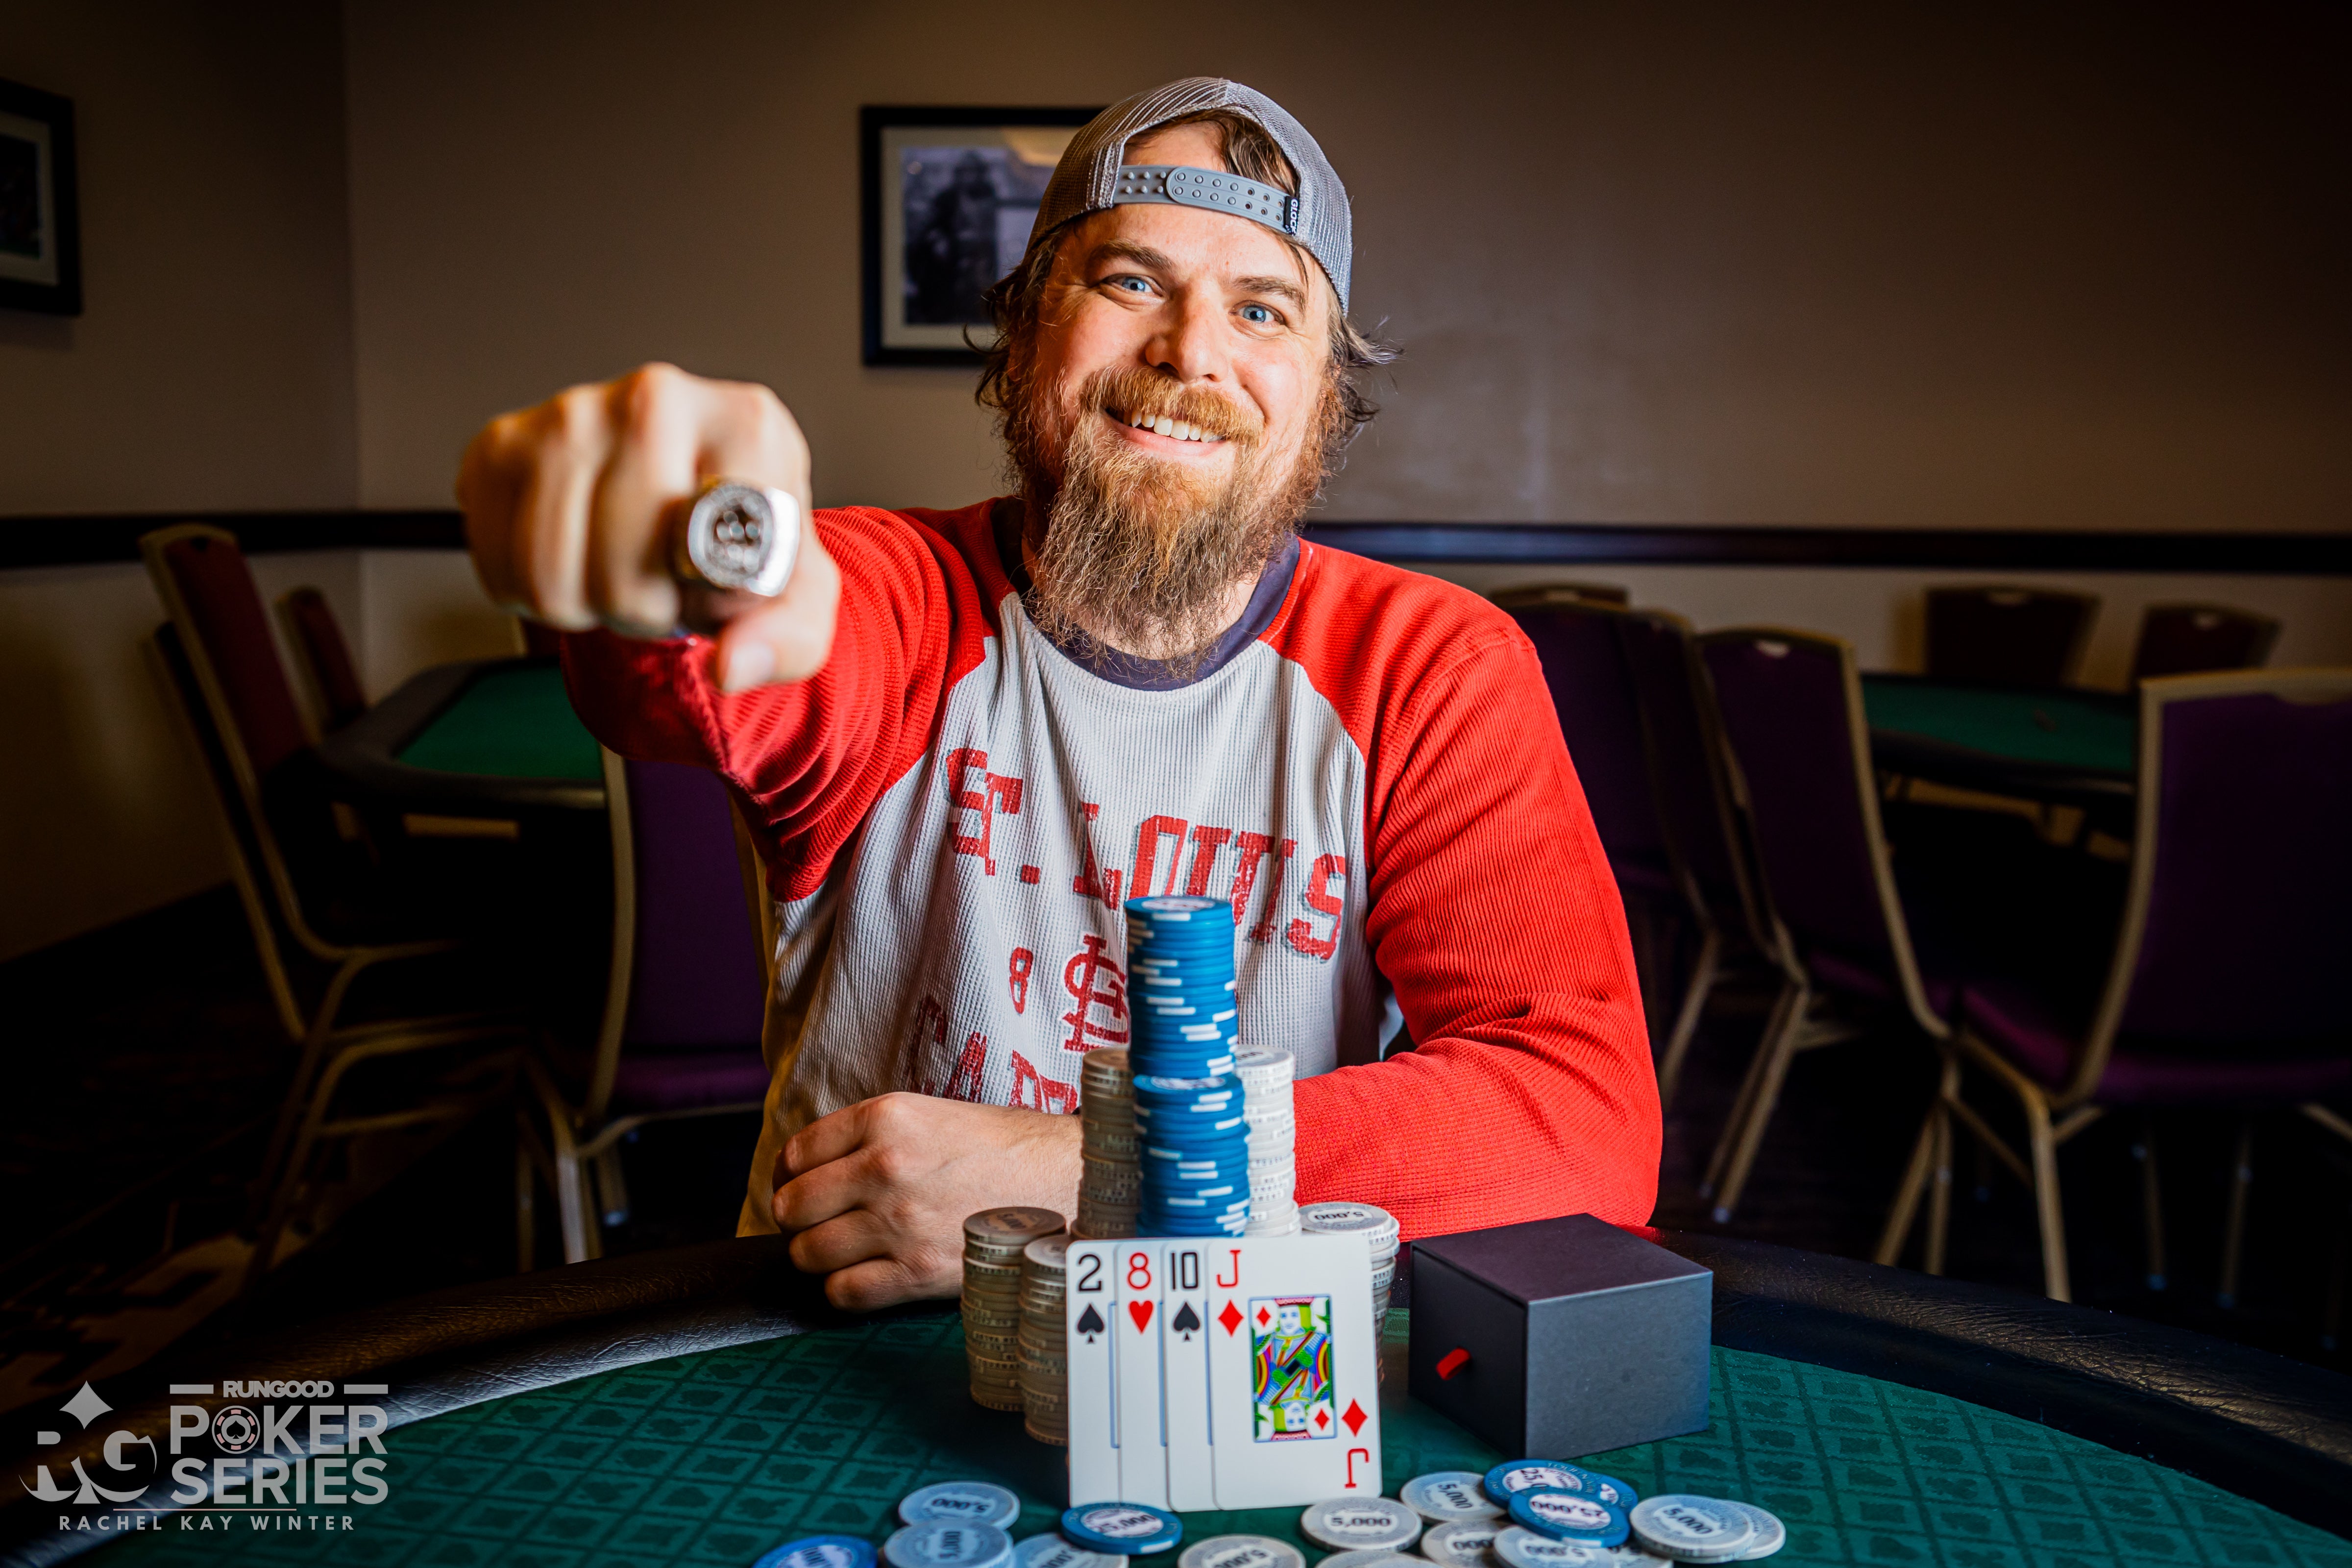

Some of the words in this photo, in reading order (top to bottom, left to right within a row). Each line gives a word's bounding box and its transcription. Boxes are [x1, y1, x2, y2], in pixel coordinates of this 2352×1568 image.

[1072, 801, 1346, 961] LOUIS
[1078, 1254, 1102, 1292] 2
[1127, 1252, 1152, 1290] 8
[1170, 1251, 1199, 1290] 10
[1217, 1250, 1241, 1289] J
[1345, 1448, 1369, 1489] J
[1438, 1483, 1473, 1509] 5,000
[1331, 1517, 1391, 1528] 5,000
